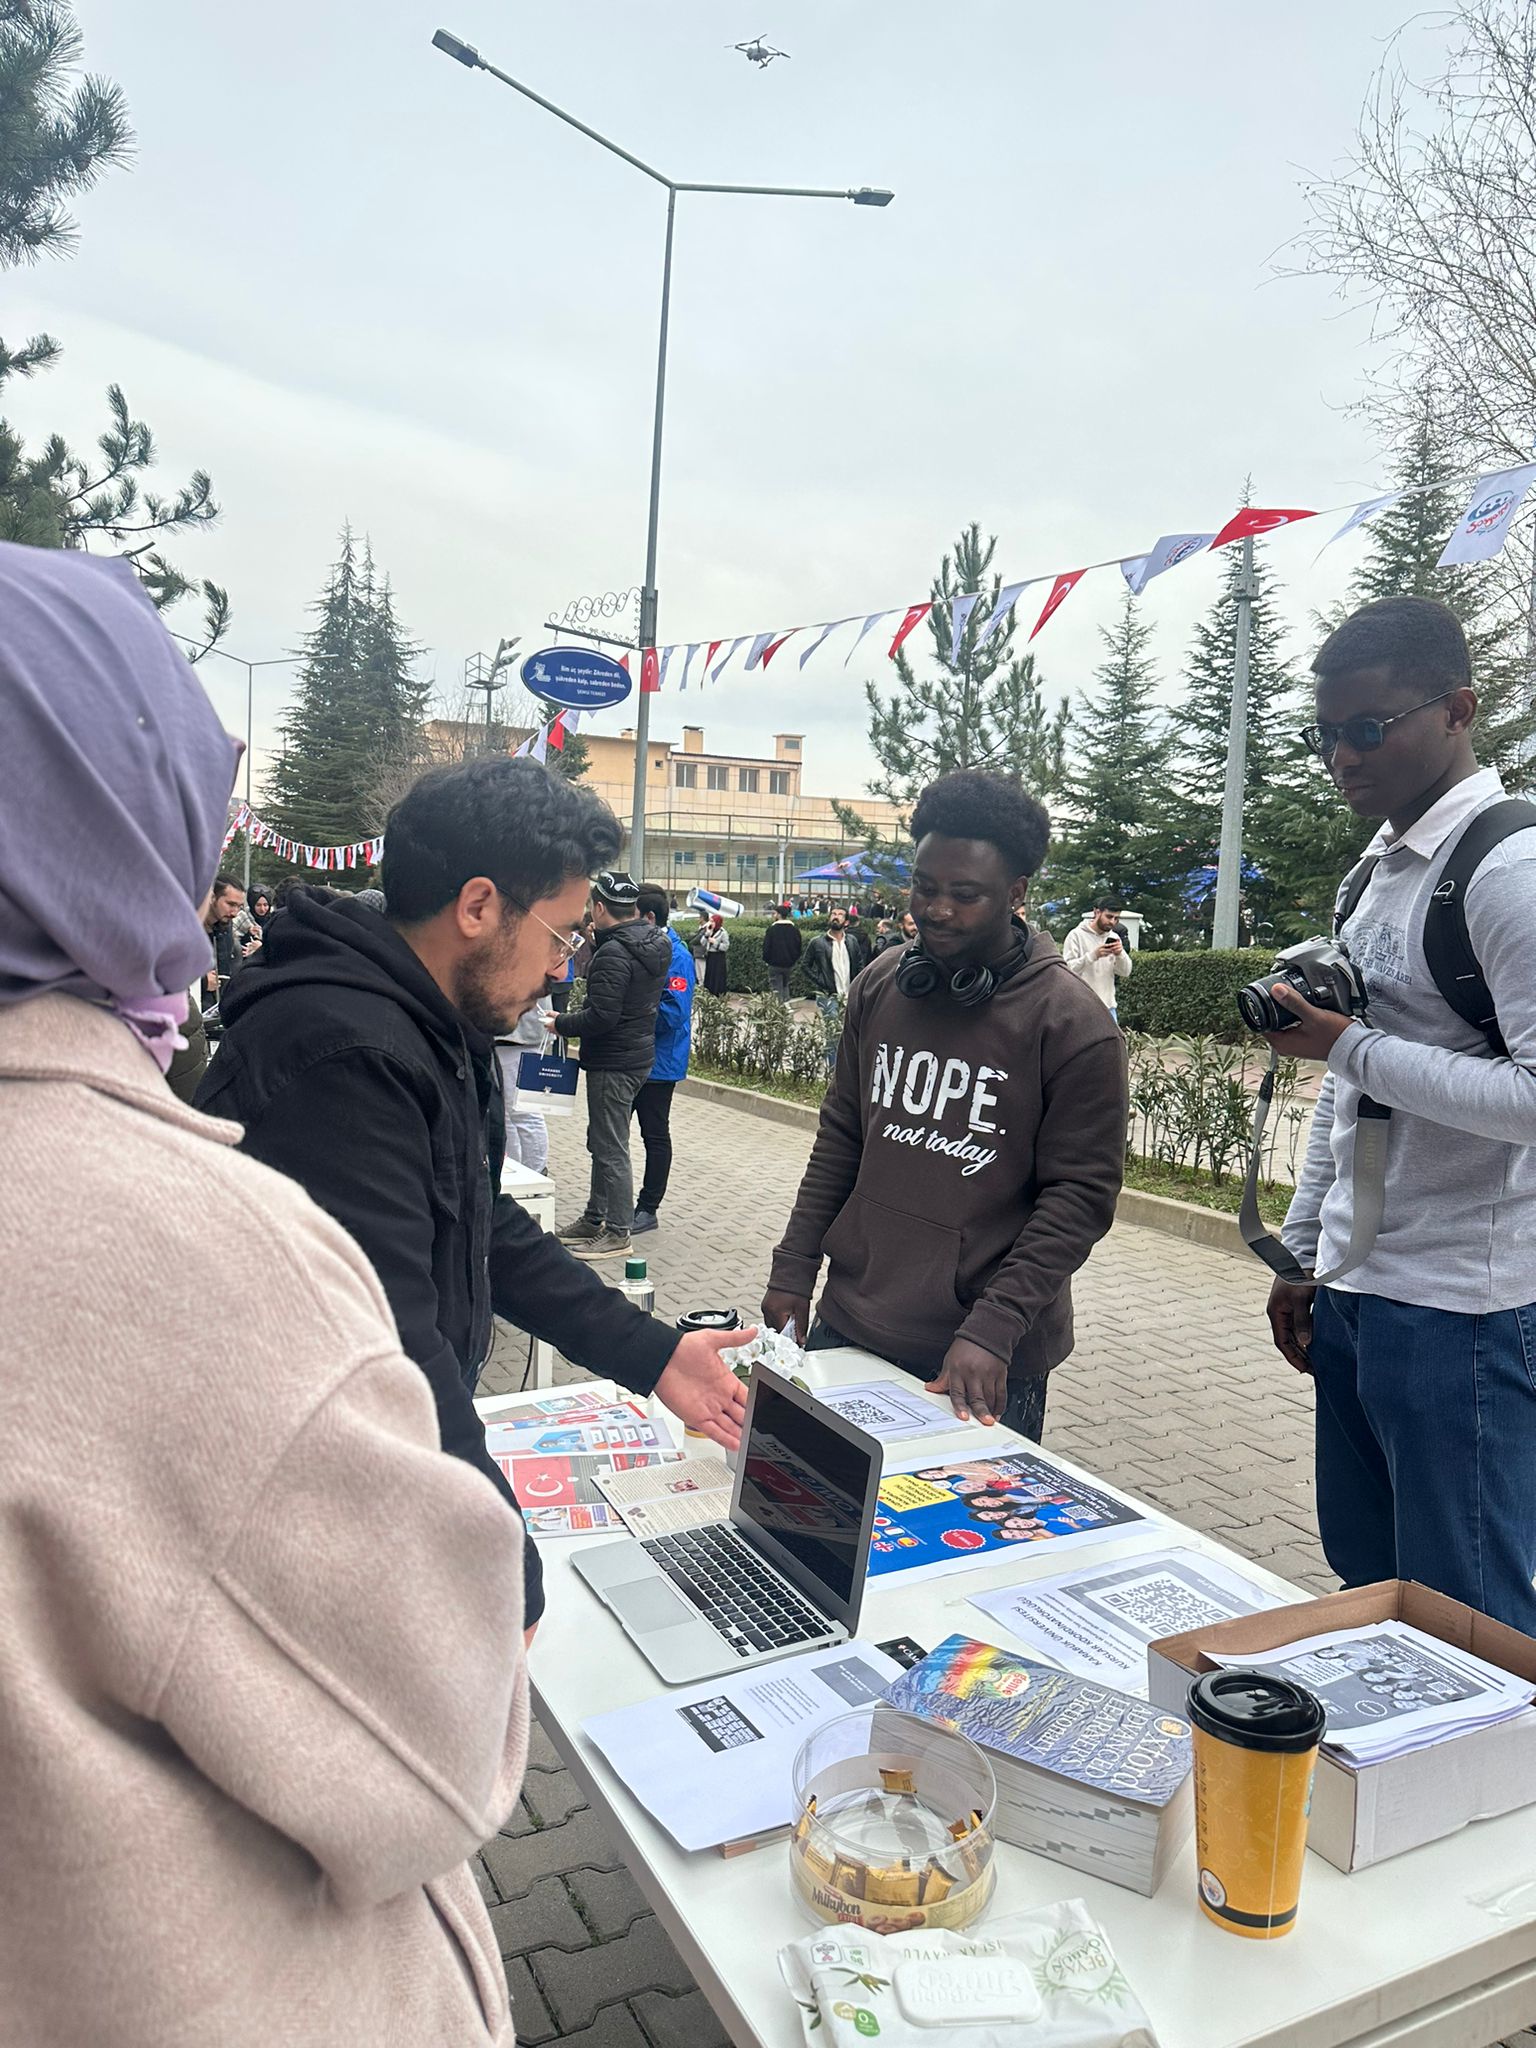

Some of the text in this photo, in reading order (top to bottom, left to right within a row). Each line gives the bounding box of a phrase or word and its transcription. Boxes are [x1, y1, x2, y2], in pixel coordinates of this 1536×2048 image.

[882, 1123, 998, 1177] not today
[1091, 1644, 1130, 1670] KURSLAR
[1026, 1687, 1106, 1756] Dictionary
[1061, 1696, 1130, 1767] LEARNER'S
[1085, 1703, 1153, 1778] ADVANCED
[1110, 1716, 1193, 1794] Oxford
